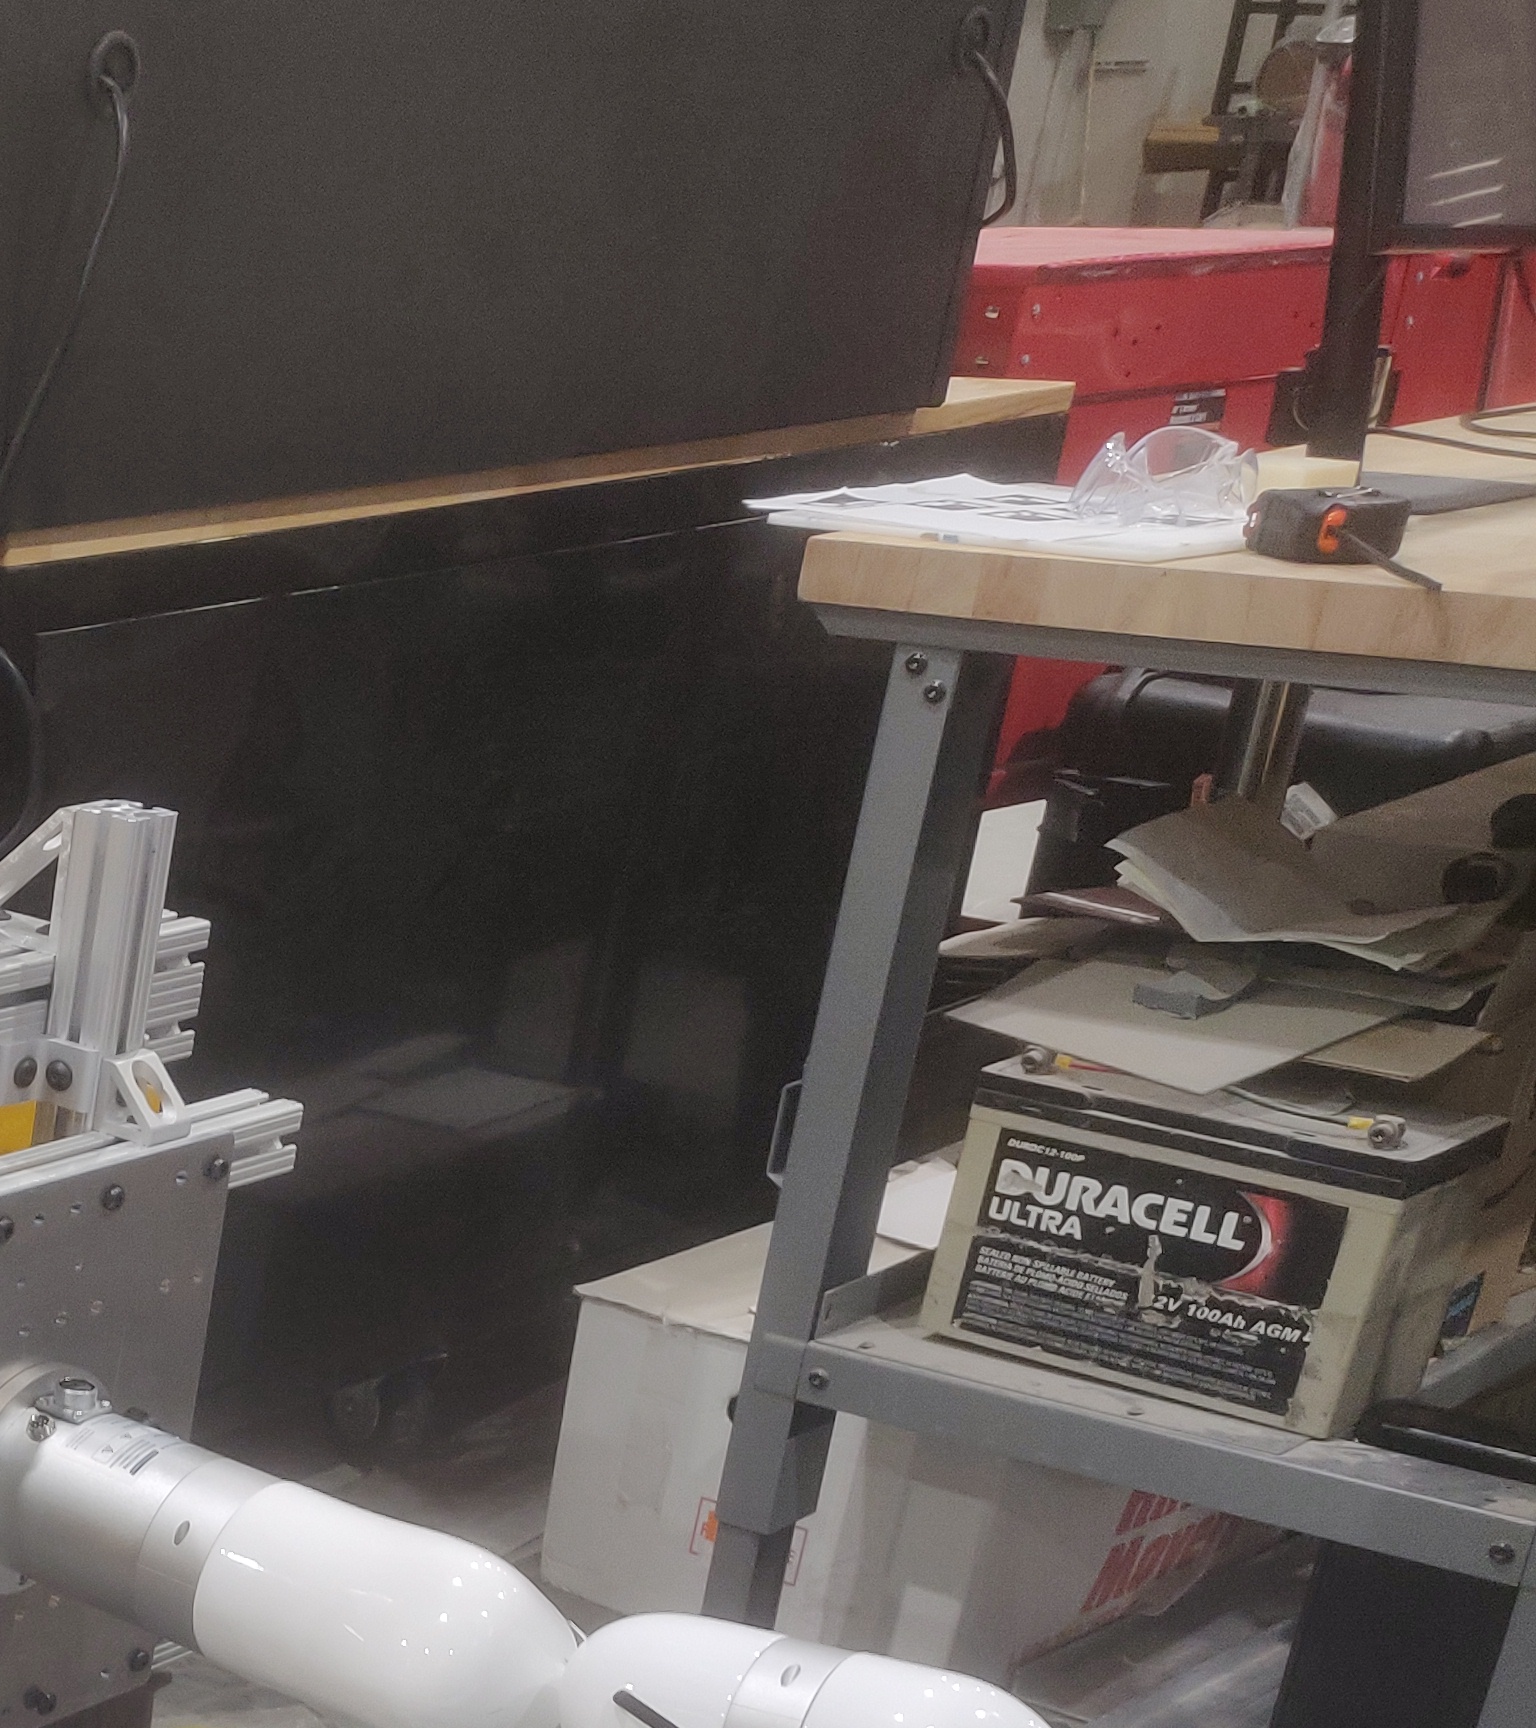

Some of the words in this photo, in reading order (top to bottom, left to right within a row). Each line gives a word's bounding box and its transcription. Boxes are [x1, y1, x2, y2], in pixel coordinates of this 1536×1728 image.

[989, 1196, 1082, 1241] ULTRA
[995, 1158, 1246, 1251] DURACELL
[979, 1246, 1012, 1261] SEALED
[1032, 1259, 1077, 1278] SPILLABLE
[1076, 1271, 1116, 1288] BATTERY
[1085, 1283, 1129, 1301] SELLADOS
[1153, 1295, 1183, 1312] 2V
[1186, 1303, 1247, 1331] 100Ah
[1249, 1320, 1303, 1343] AGM
